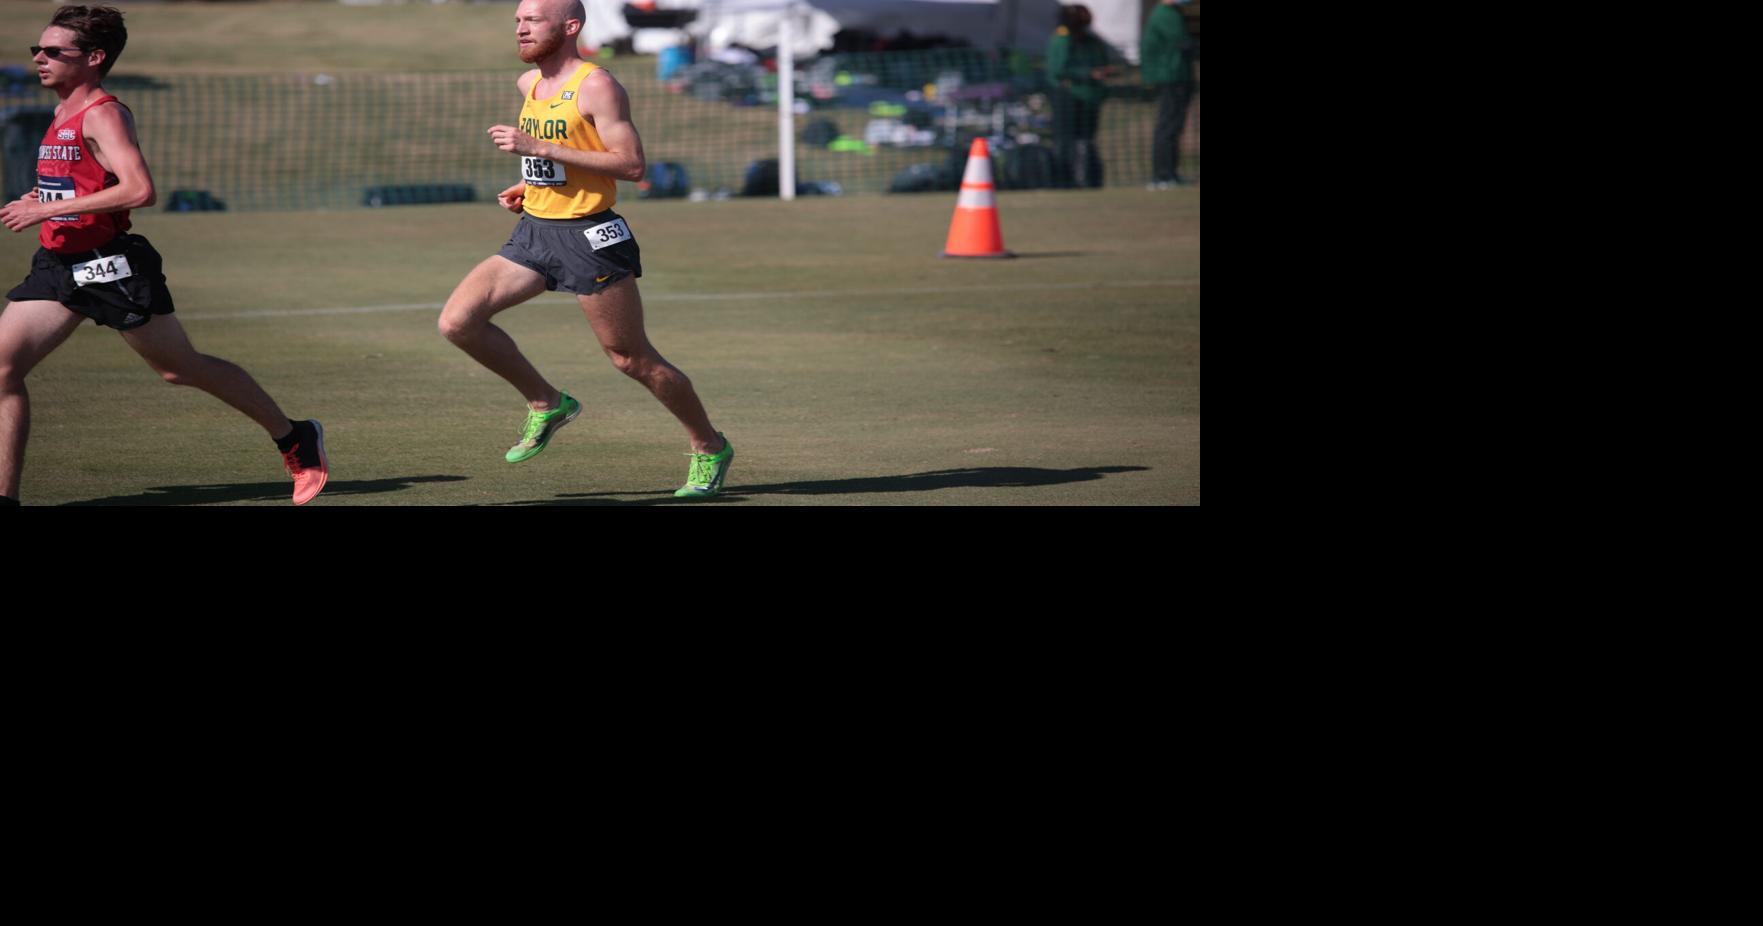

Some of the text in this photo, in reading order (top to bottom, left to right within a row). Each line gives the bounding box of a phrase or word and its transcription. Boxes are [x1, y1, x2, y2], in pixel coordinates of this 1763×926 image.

[52, 145, 81, 160] STATE
[525, 158, 555, 179] 353
[596, 223, 624, 242] 353
[84, 261, 118, 280] 344
